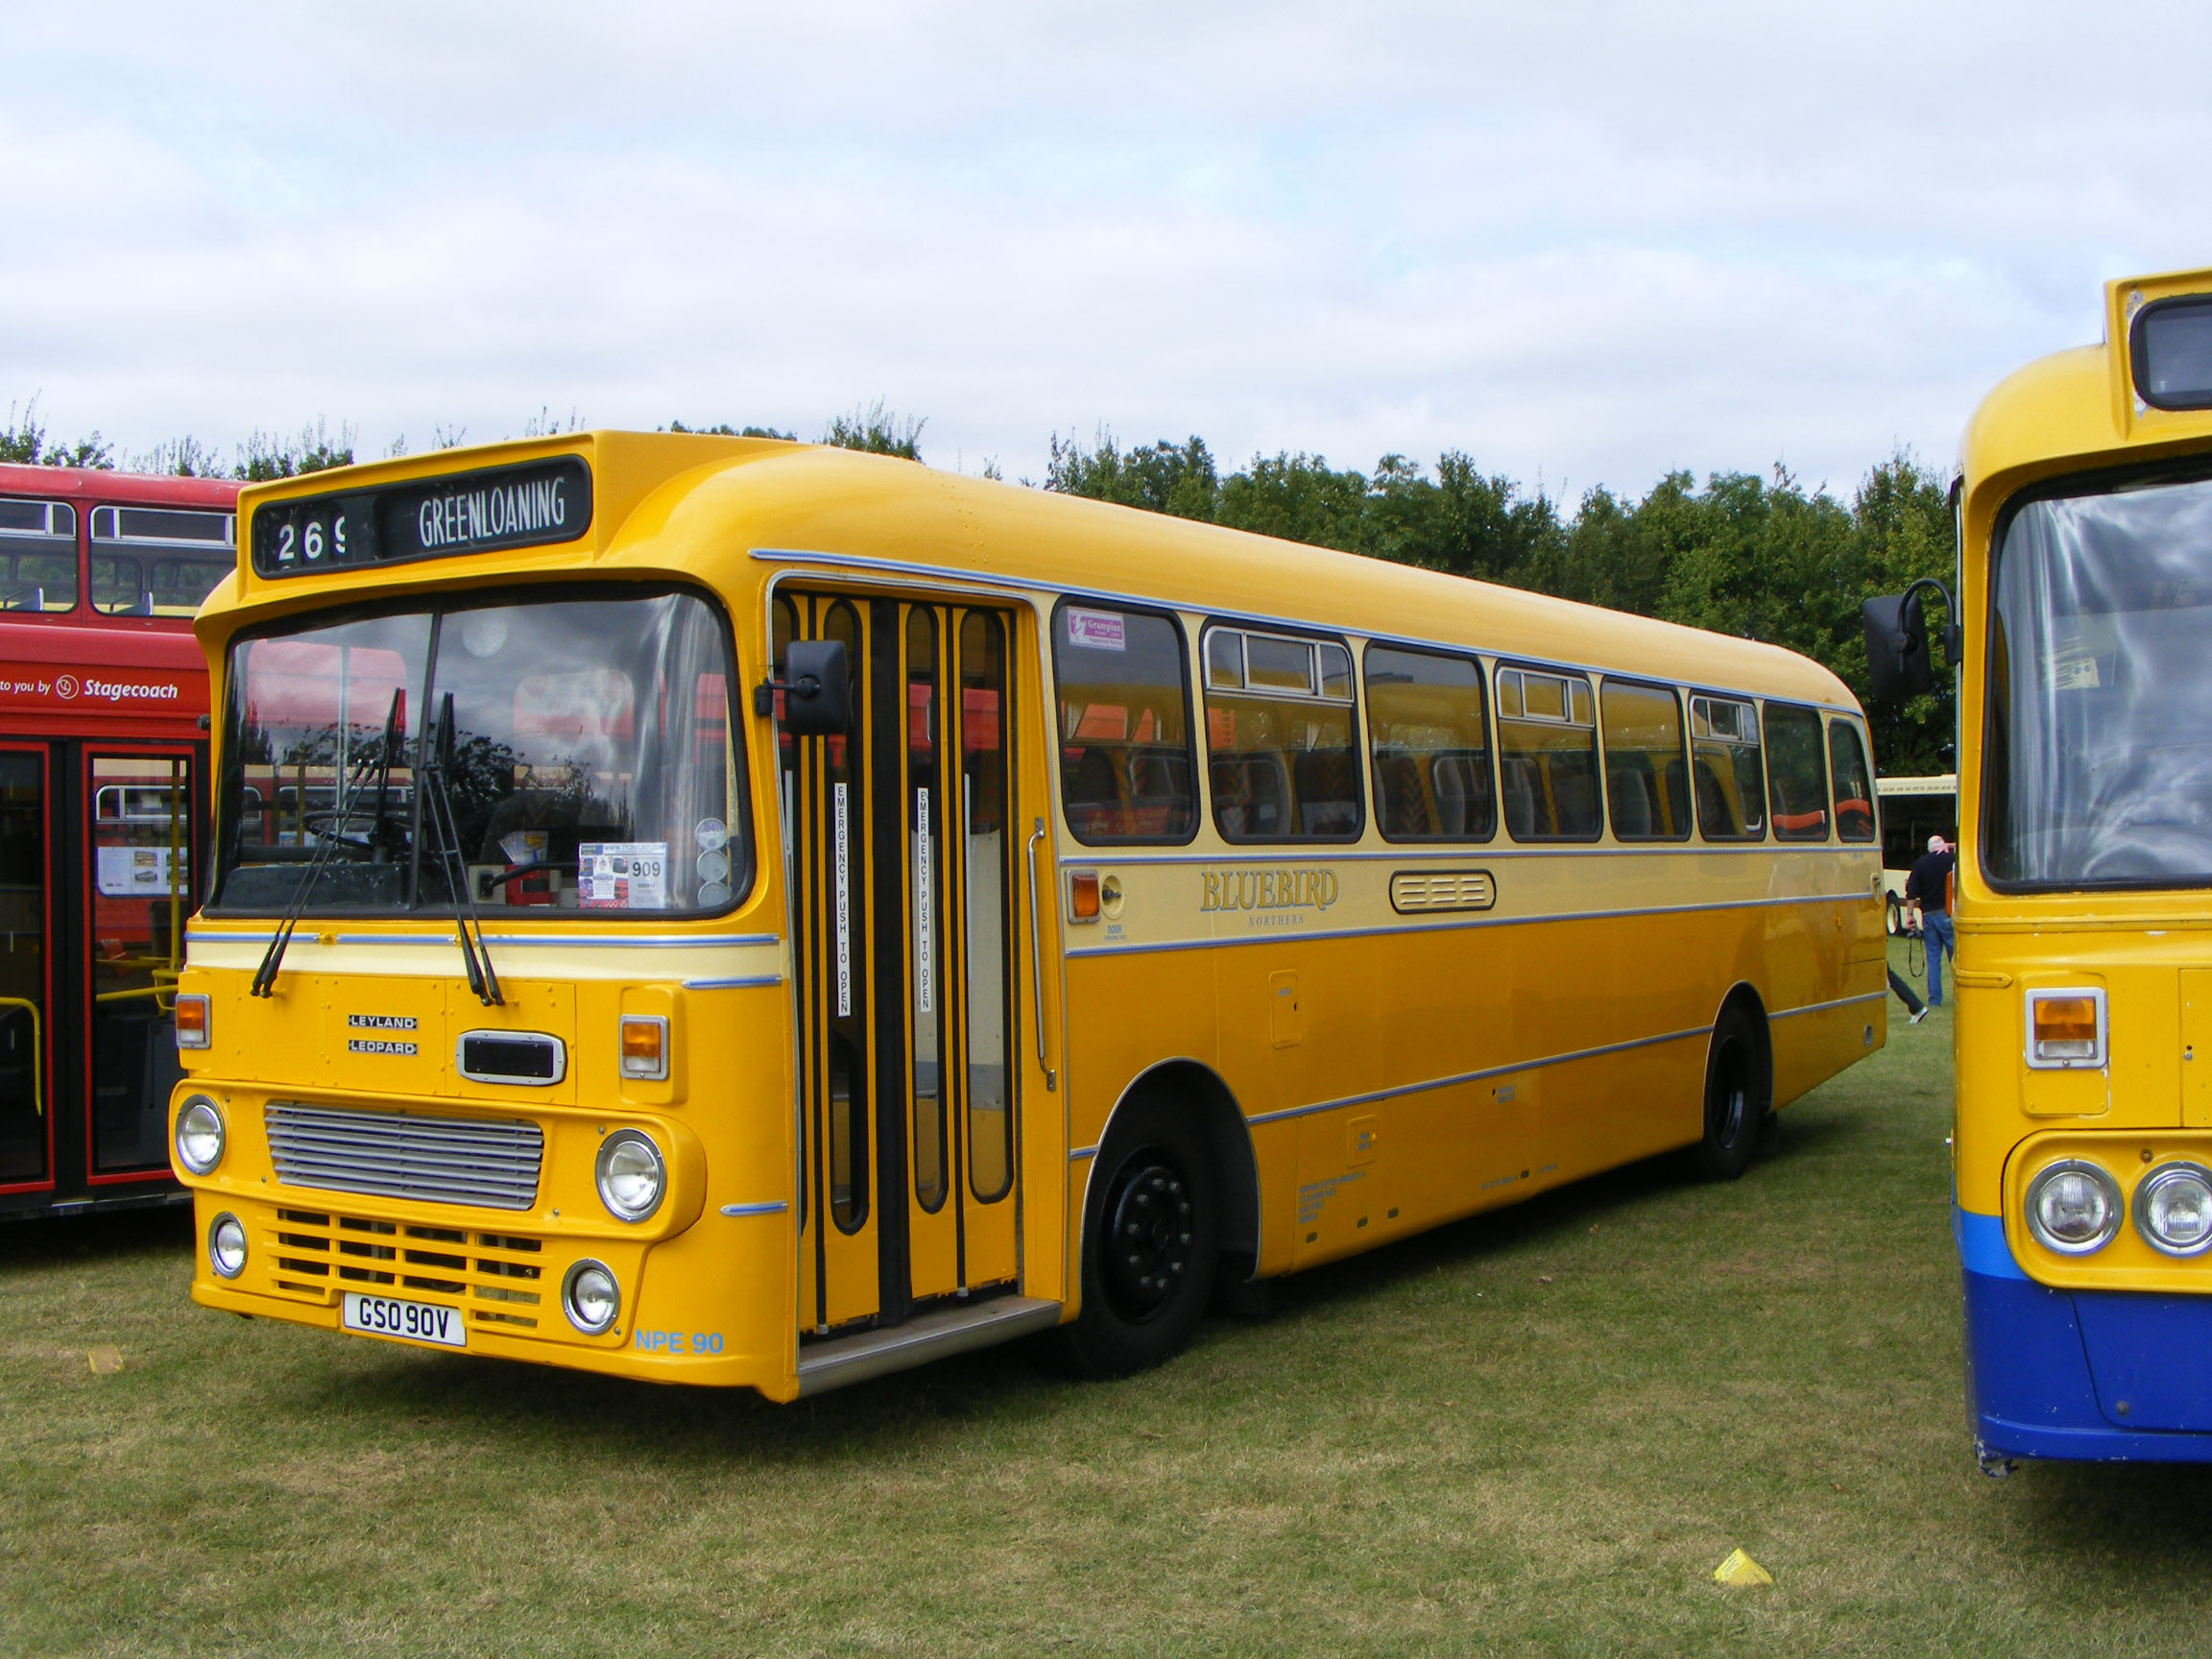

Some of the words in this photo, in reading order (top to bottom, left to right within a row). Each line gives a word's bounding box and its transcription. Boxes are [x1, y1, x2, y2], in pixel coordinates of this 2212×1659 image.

[419, 477, 565, 547] GREENLOANING
[14, 681, 35, 694] you
[37, 680, 51, 696] by
[84, 679, 179, 701] Stagecoach
[837, 786, 846, 884] EMERGENCY
[920, 791, 928, 885] EMERGENCY
[632, 861, 661, 878] 909
[1200, 868, 1339, 912] BLUEBIRD
[838, 890, 847, 933] PUSH
[1248, 914, 1305, 928] NORTHERN
[840, 942, 848, 964] TO
[922, 940, 928, 961] TO
[840, 971, 849, 1013] OPEN
[922, 969, 930, 1009] OPEN
[351, 1016, 414, 1028] LEYLAND
[351, 1041, 415, 1054] LEOPARD
[635, 1329, 684, 1354] NPE
[691, 1332, 724, 1355] 90
